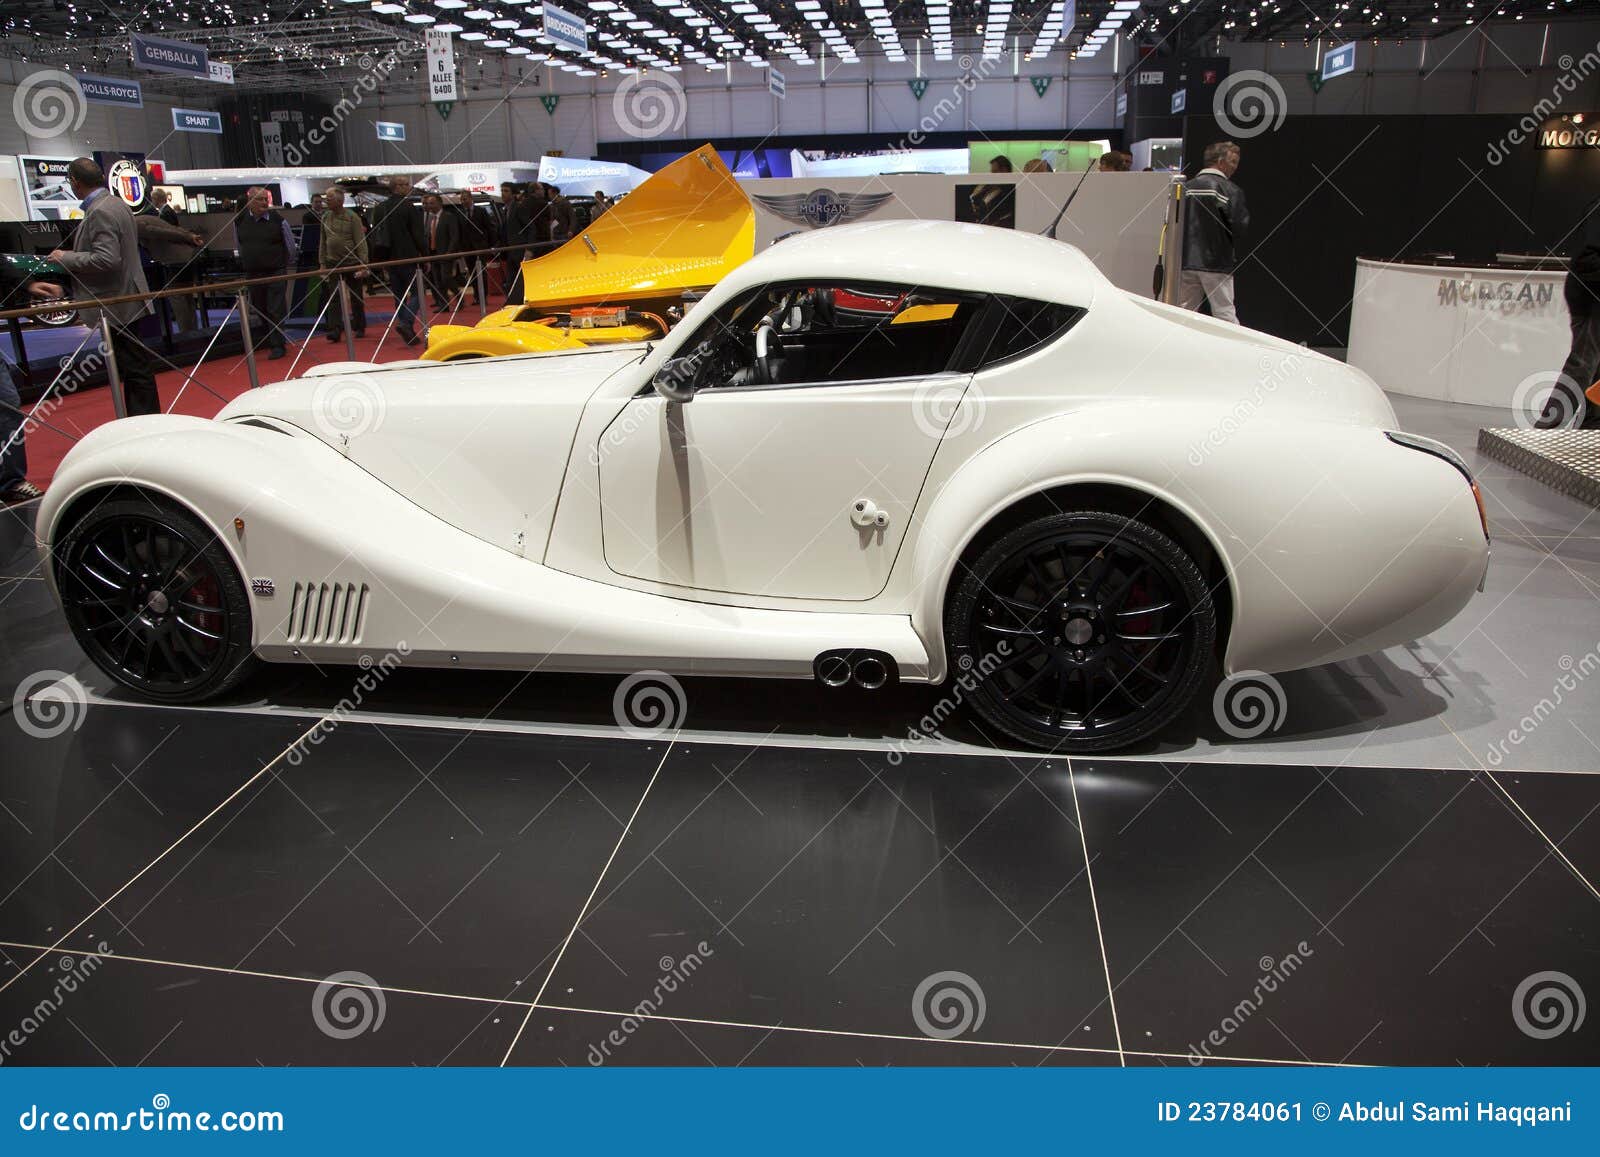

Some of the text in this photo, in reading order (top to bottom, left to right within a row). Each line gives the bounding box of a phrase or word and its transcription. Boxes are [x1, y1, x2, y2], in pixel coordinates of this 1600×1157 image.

[547, 17, 585, 42] BRIDGESTONE
[146, 46, 198, 66] GEMBALLA
[438, 60, 444, 72] 6
[432, 73, 452, 83] ALLEE
[82, 83, 138, 99] ROLLS-ROYCE
[434, 84, 452, 95] 6400
[185, 115, 210, 127] SMART
[264, 134, 280, 144] WC
[562, 167, 623, 177] Mercedes-Benz
[800, 204, 846, 214] MORGAN
[1437, 279, 1554, 302] MORGAN
